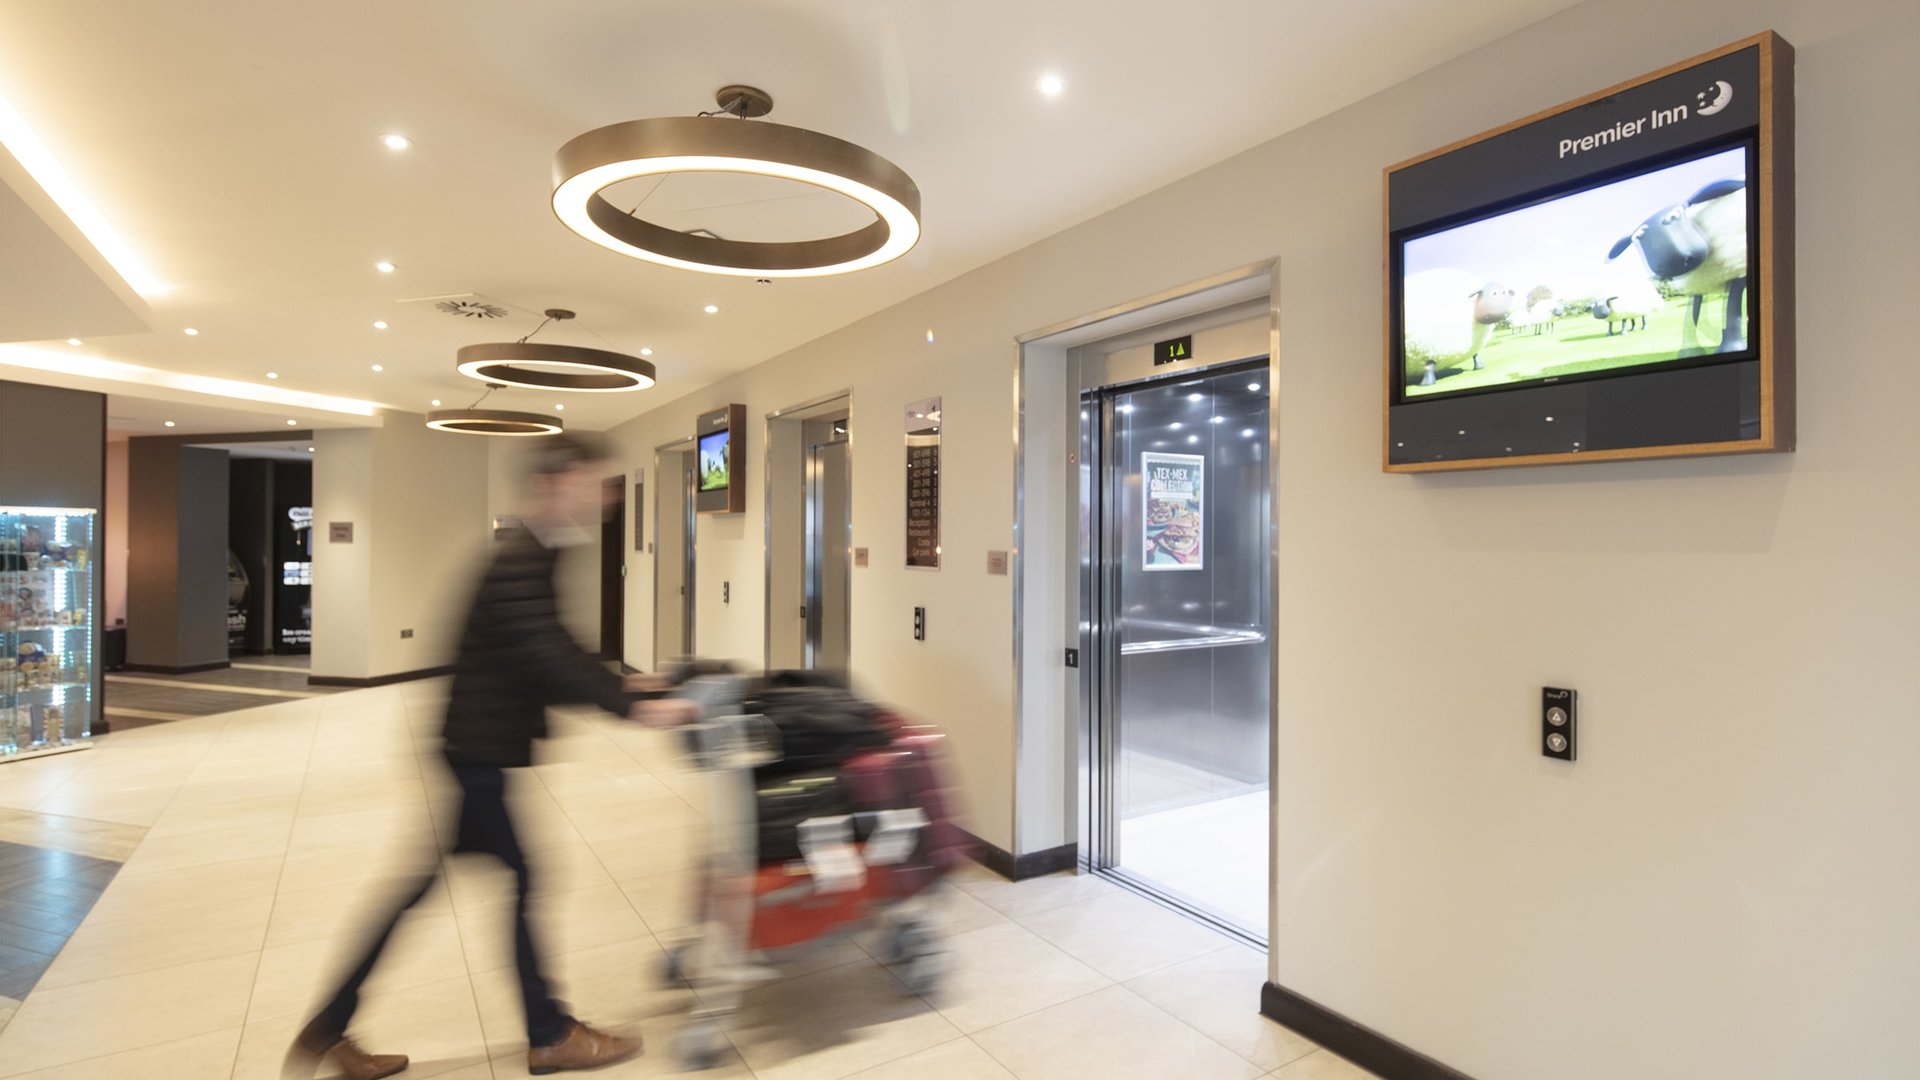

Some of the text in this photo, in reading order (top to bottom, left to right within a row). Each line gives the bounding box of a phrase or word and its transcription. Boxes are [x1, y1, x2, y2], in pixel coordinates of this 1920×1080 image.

[1559, 104, 1688, 159] Premier Inn
[1169, 344, 1175, 357] 1
[1156, 467, 1187, 480] TEX-MEX
[1068, 653, 1073, 665] 1
